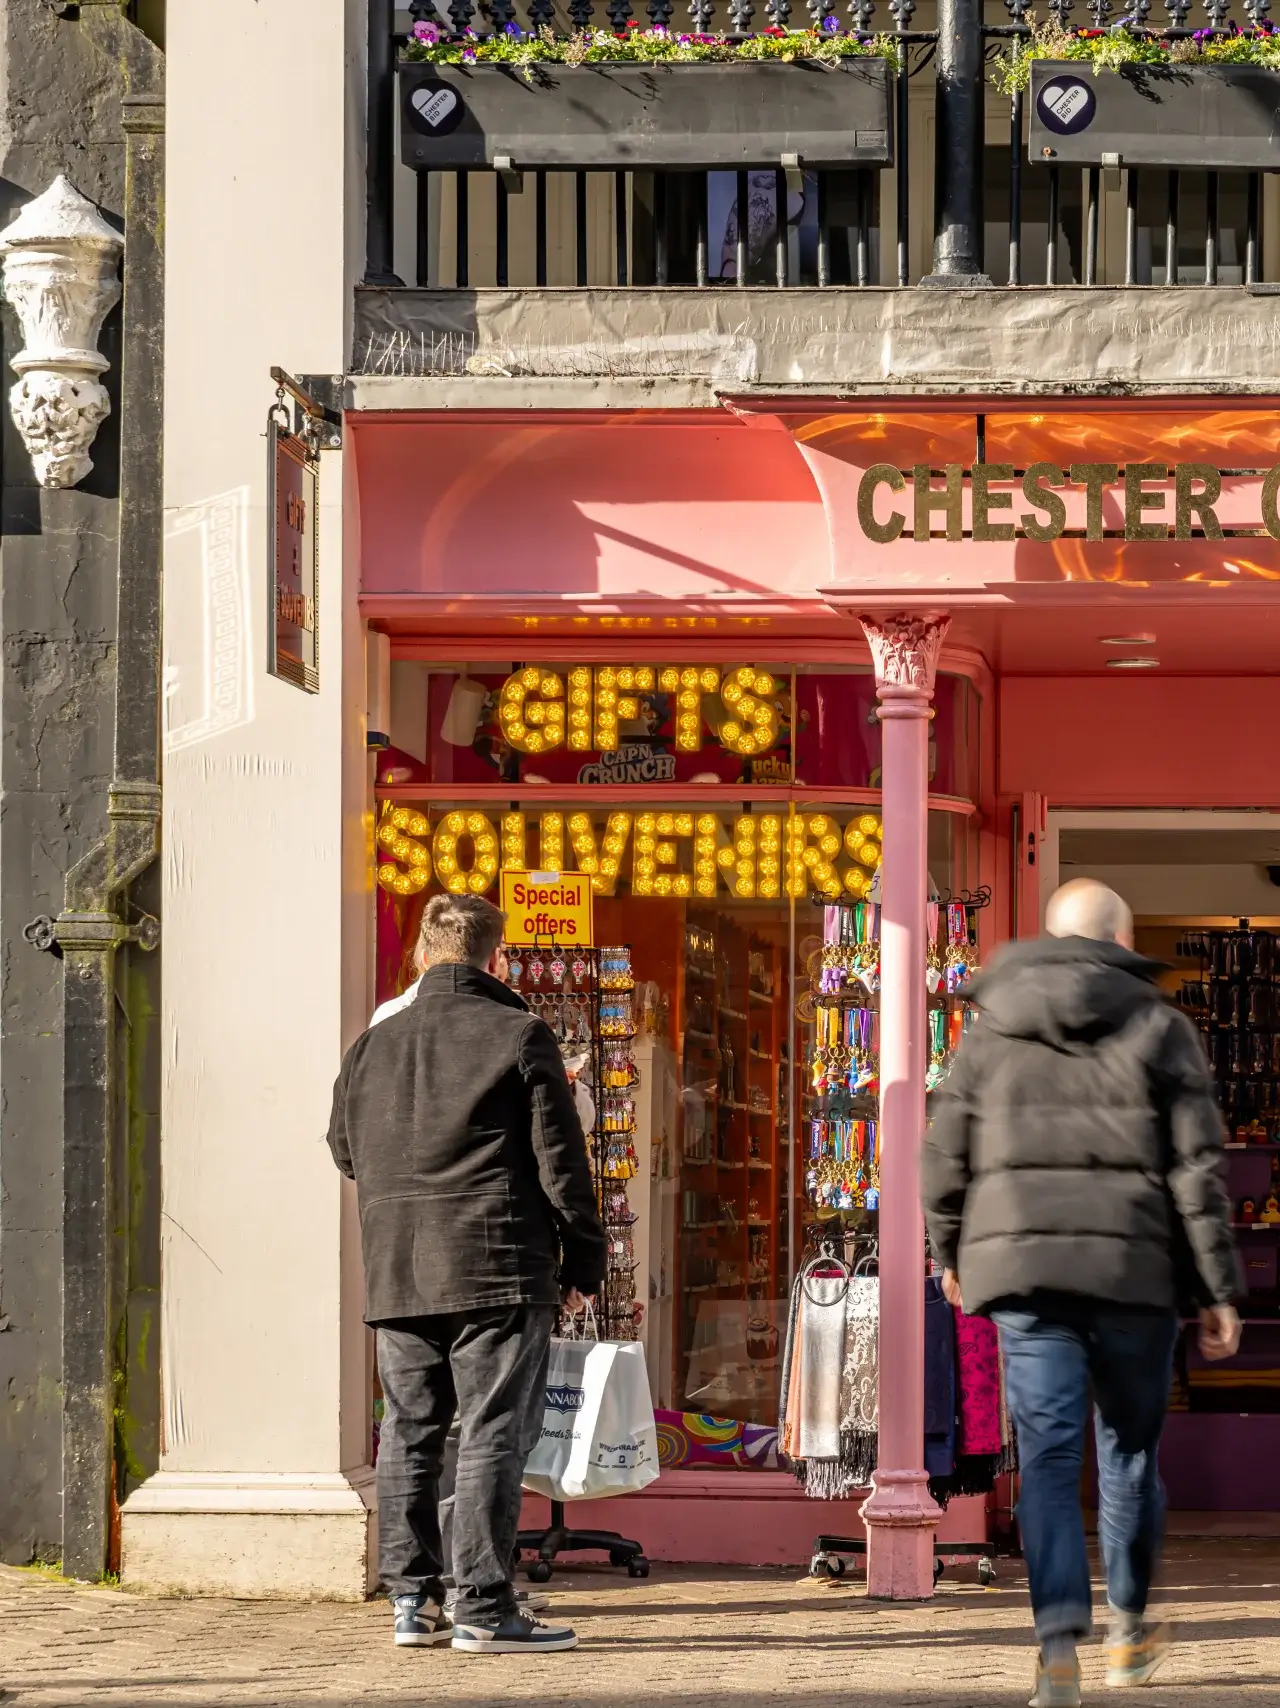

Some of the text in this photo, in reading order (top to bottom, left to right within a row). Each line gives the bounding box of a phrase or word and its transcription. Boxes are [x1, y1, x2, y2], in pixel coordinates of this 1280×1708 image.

[425, 92, 448, 117] CHESTER
[1056, 89, 1080, 115] CHESTER
[1060, 107, 1072, 119] BID
[429, 110, 440, 121] BID
[856, 462, 1226, 544] CHESTER
[499, 666, 779, 754] GIFTS
[582, 755, 675, 784] CRUNCH
[375, 806, 883, 899] SOUVENIRS
[513, 883, 581, 910] Special
[523, 912, 577, 935] offers
